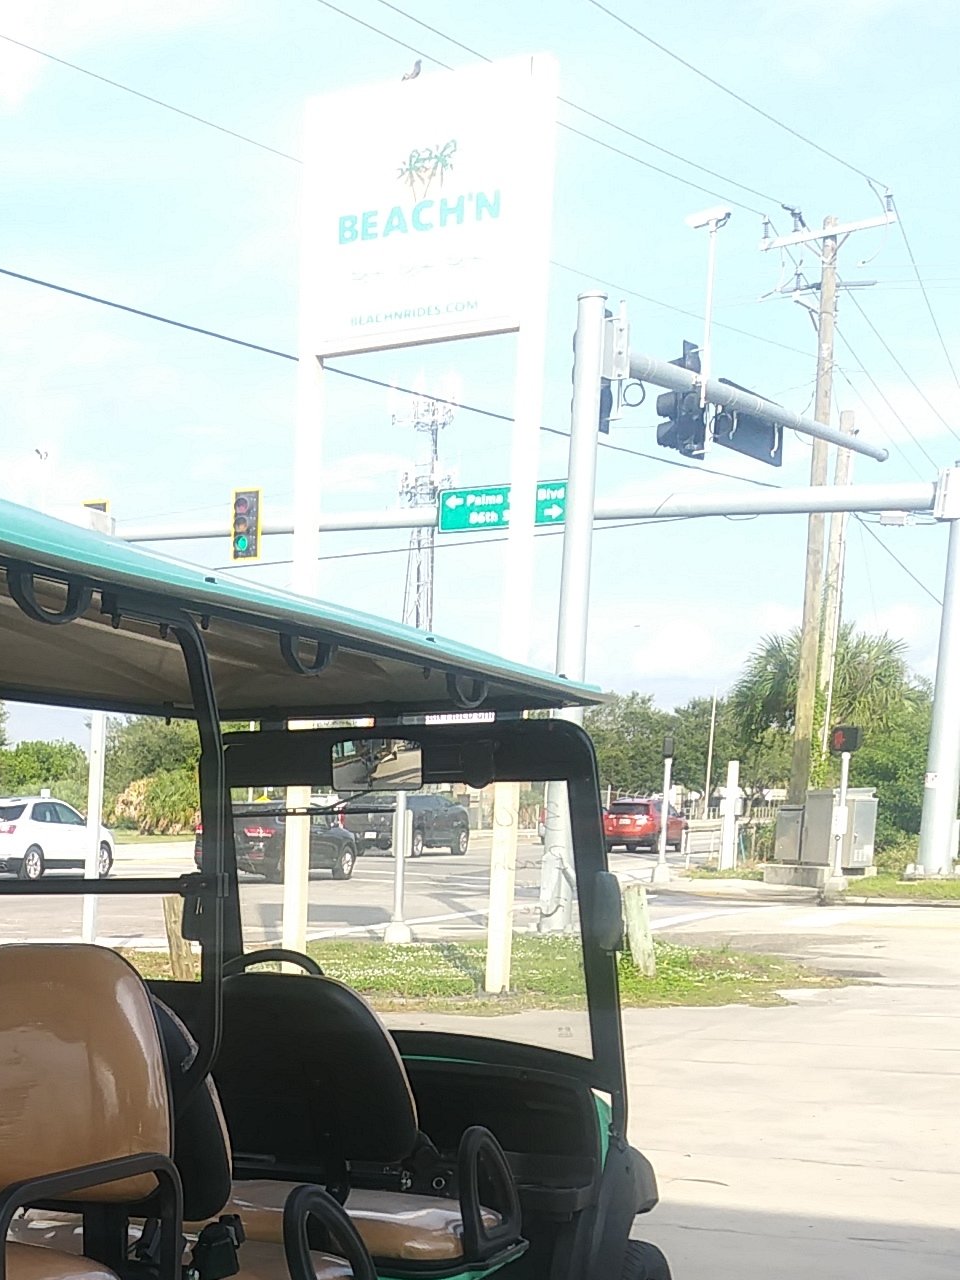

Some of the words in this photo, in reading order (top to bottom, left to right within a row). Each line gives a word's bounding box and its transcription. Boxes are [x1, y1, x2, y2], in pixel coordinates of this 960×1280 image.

[338, 189, 501, 245] BEACH'N
[466, 494, 504, 507] Palma
[537, 487, 565, 501] Blvd
